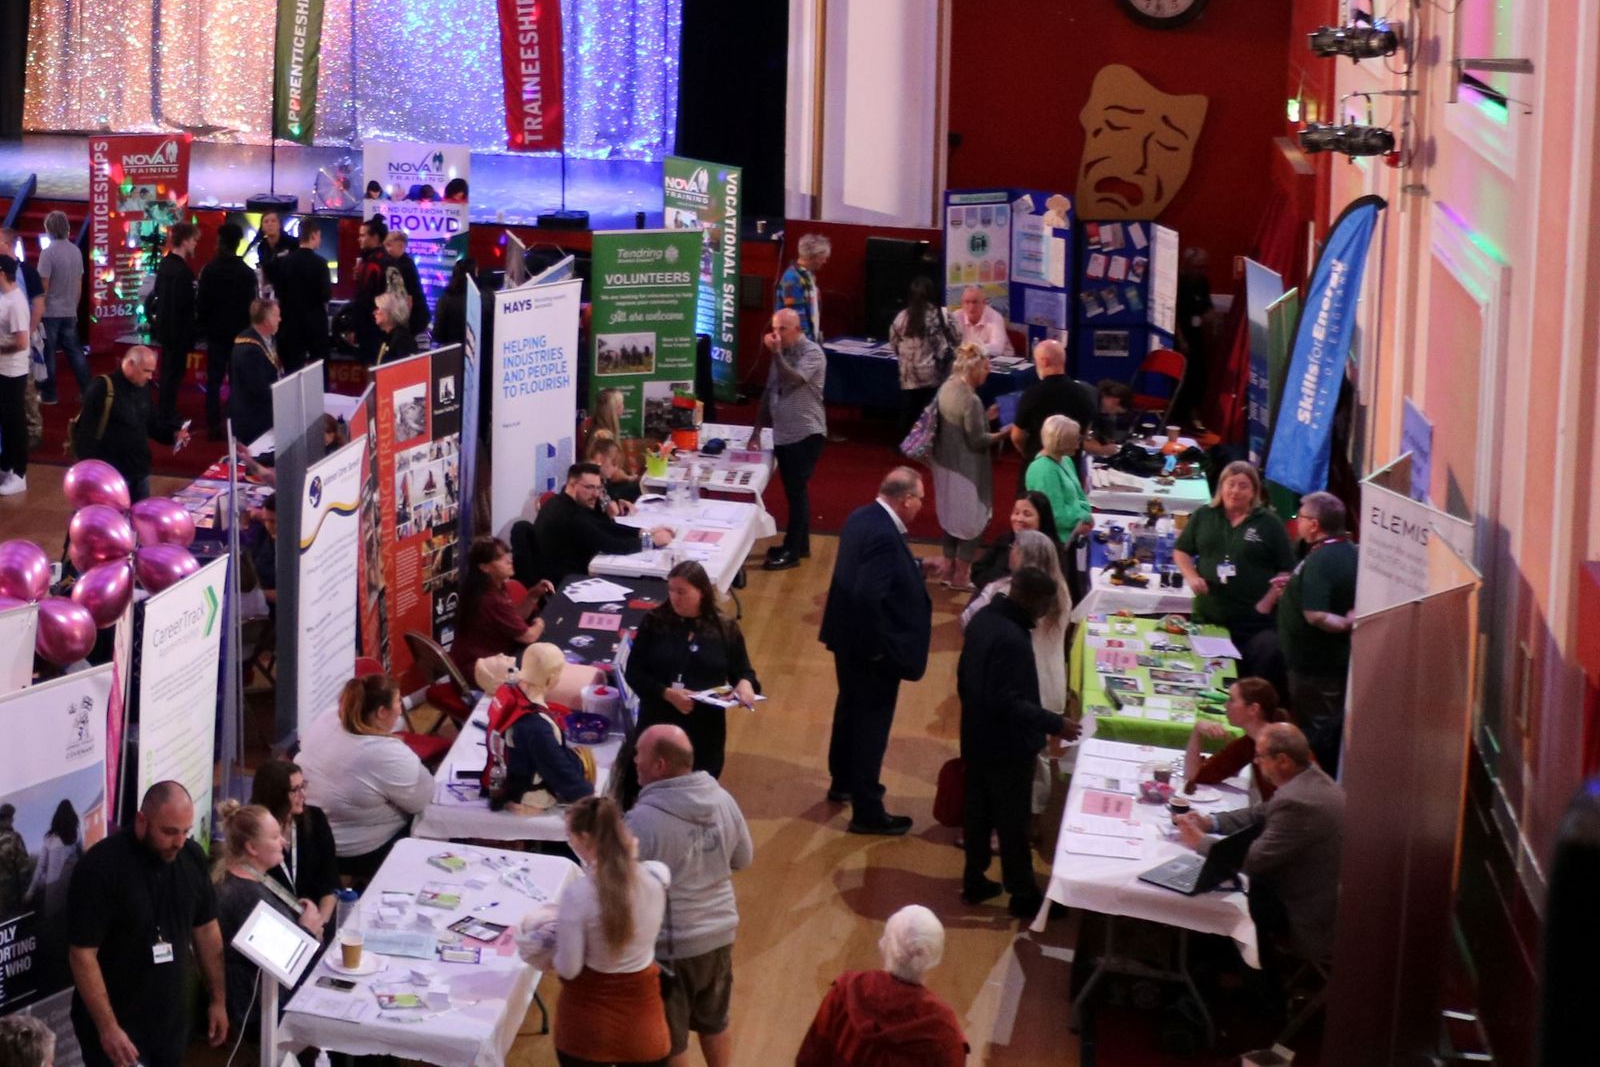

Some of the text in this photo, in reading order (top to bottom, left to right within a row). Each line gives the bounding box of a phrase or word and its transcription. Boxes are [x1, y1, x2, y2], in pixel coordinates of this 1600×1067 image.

[122, 148, 167, 166] NOVA
[388, 157, 432, 173] NOVA
[665, 172, 701, 194] NOVA
[665, 190, 709, 205] TRAINING
[94, 141, 109, 301] APPRENTICESHIPS
[401, 206, 418, 214] OUT
[420, 207, 443, 215] FROM
[617, 248, 663, 260] Tendring
[722, 173, 738, 343] VOCATIONAL SKILLS
[604, 272, 691, 285] VOLUNTEERS
[503, 299, 533, 314] HAYS
[503, 335, 547, 354] HELPING
[503, 347, 564, 370] INDUSTRIES
[502, 361, 568, 384] AND PEOPLE
[503, 375, 571, 399] TO FLOURISH
[379, 395, 392, 467] TRUST
[381, 476, 394, 571] SAILING
[1371, 506, 1429, 546] ELEMIS
[5, 956, 32, 979] WHO
